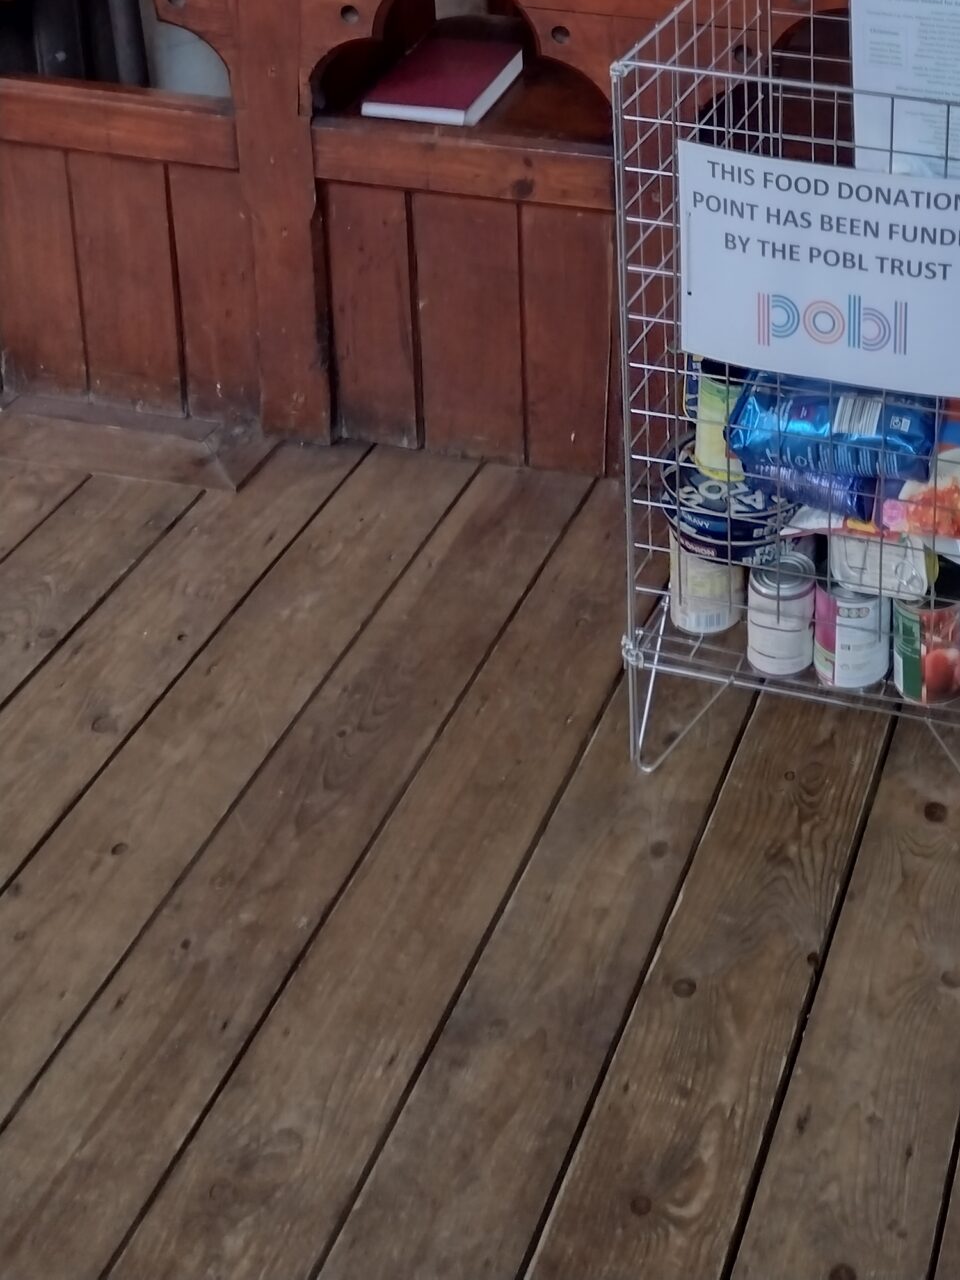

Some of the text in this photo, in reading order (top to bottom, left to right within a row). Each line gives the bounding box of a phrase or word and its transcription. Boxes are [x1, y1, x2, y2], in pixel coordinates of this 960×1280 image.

[707, 160, 756, 187] THIS
[763, 172, 830, 197] FOOD
[692, 190, 759, 222] POINT
[766, 206, 813, 230] HAS
[819, 214, 880, 239] BEEN
[724, 232, 953, 281] BY THE POBL TRUST
